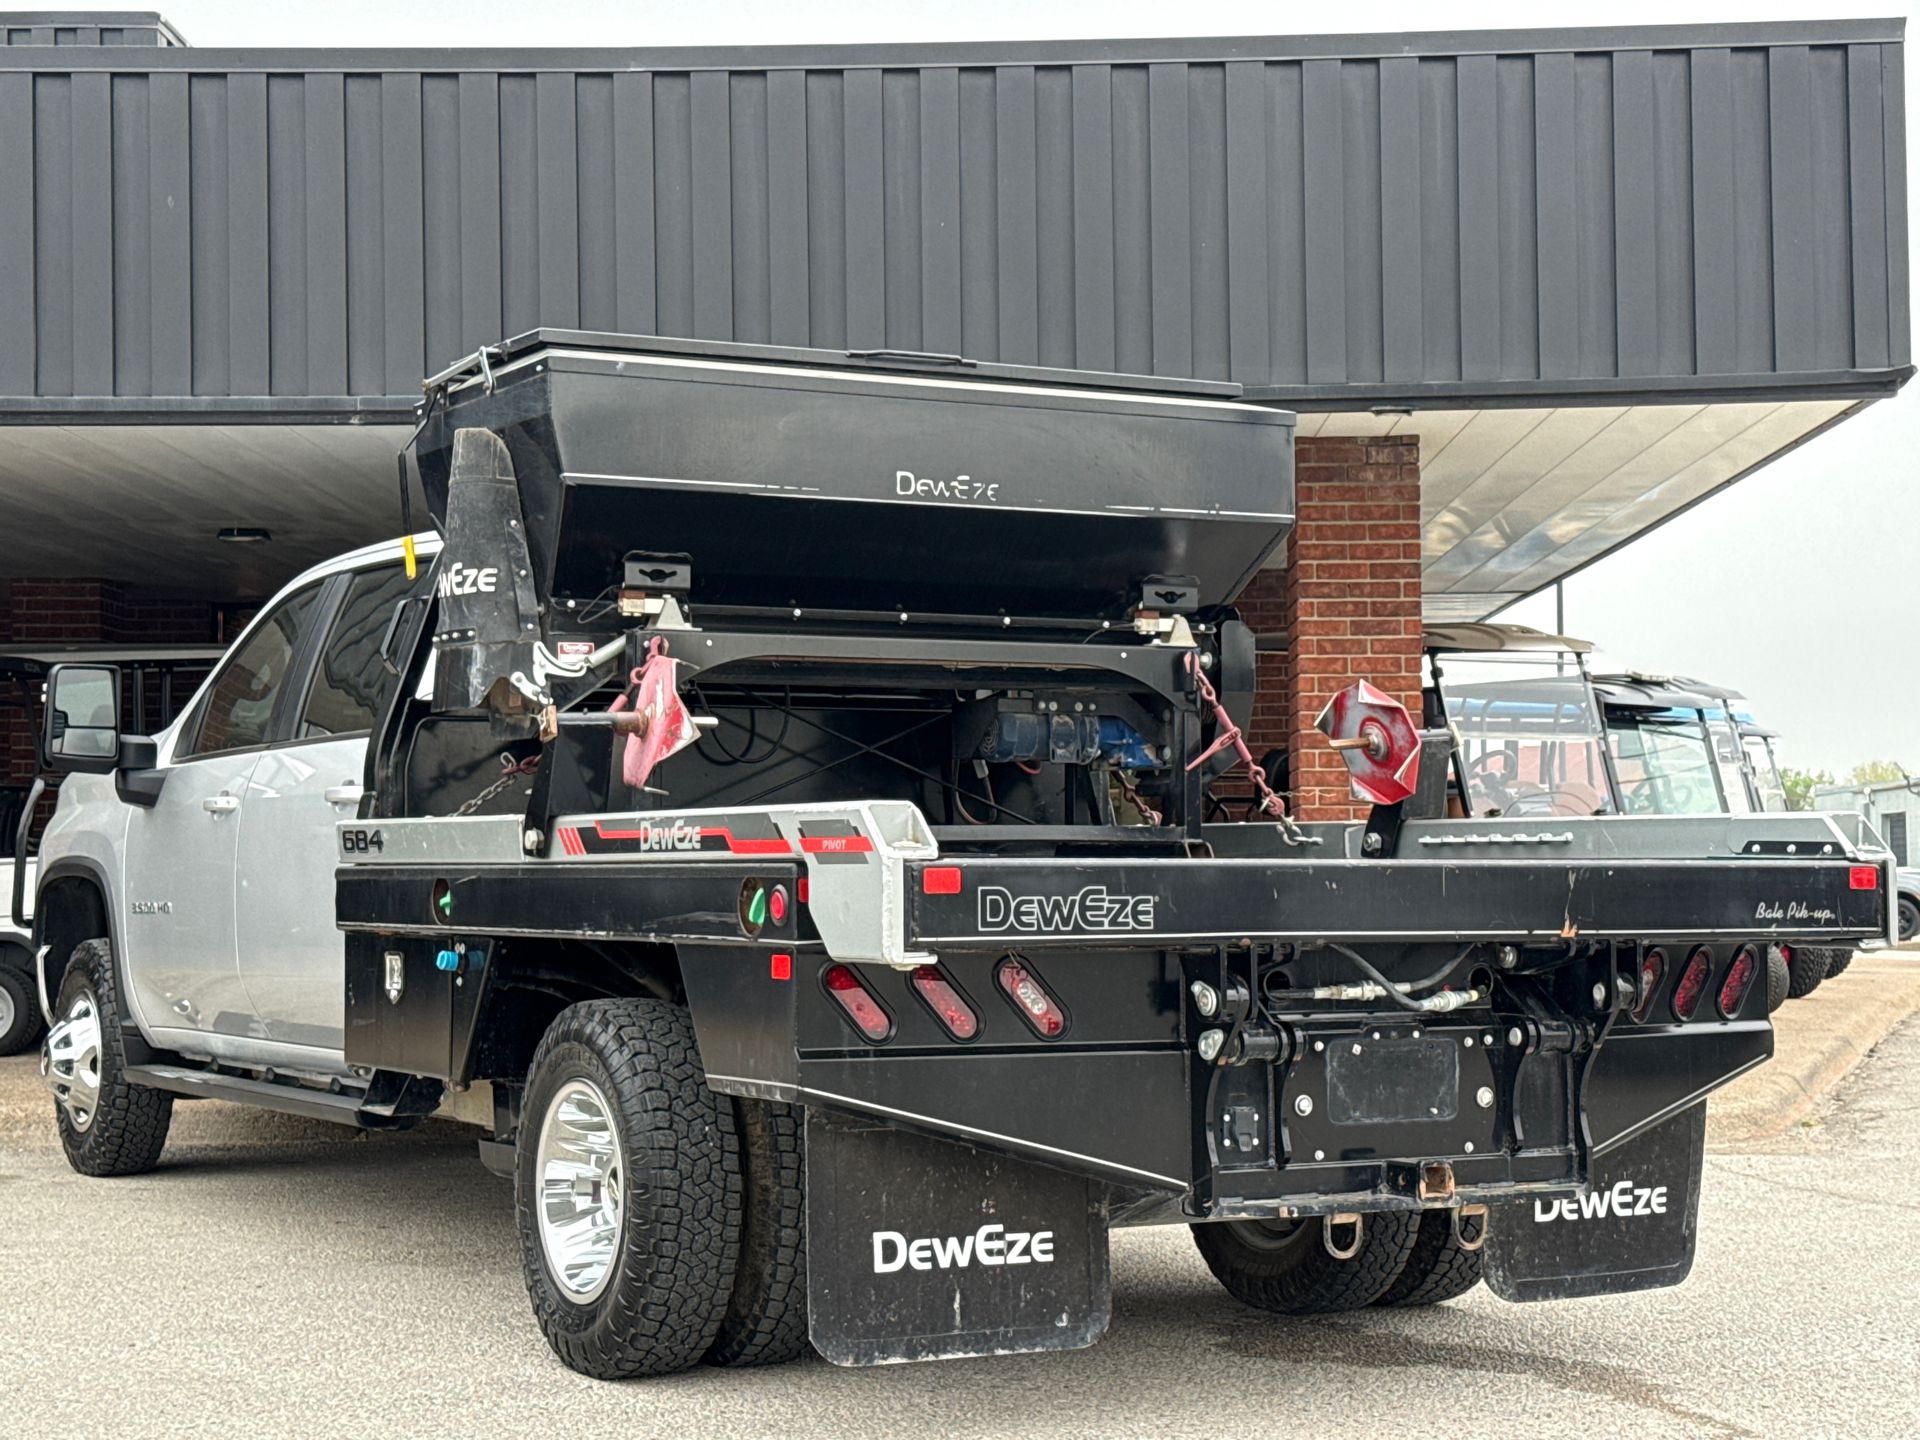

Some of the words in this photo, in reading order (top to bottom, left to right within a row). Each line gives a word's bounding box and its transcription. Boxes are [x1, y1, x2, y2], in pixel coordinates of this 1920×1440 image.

[342, 829, 384, 853] 684
[640, 819, 701, 850] DewEze
[822, 839, 846, 850] PIVOT
[978, 886, 1154, 931] DewEze
[1755, 901, 1783, 919] Bale
[873, 1224, 1054, 1273] DewEze
